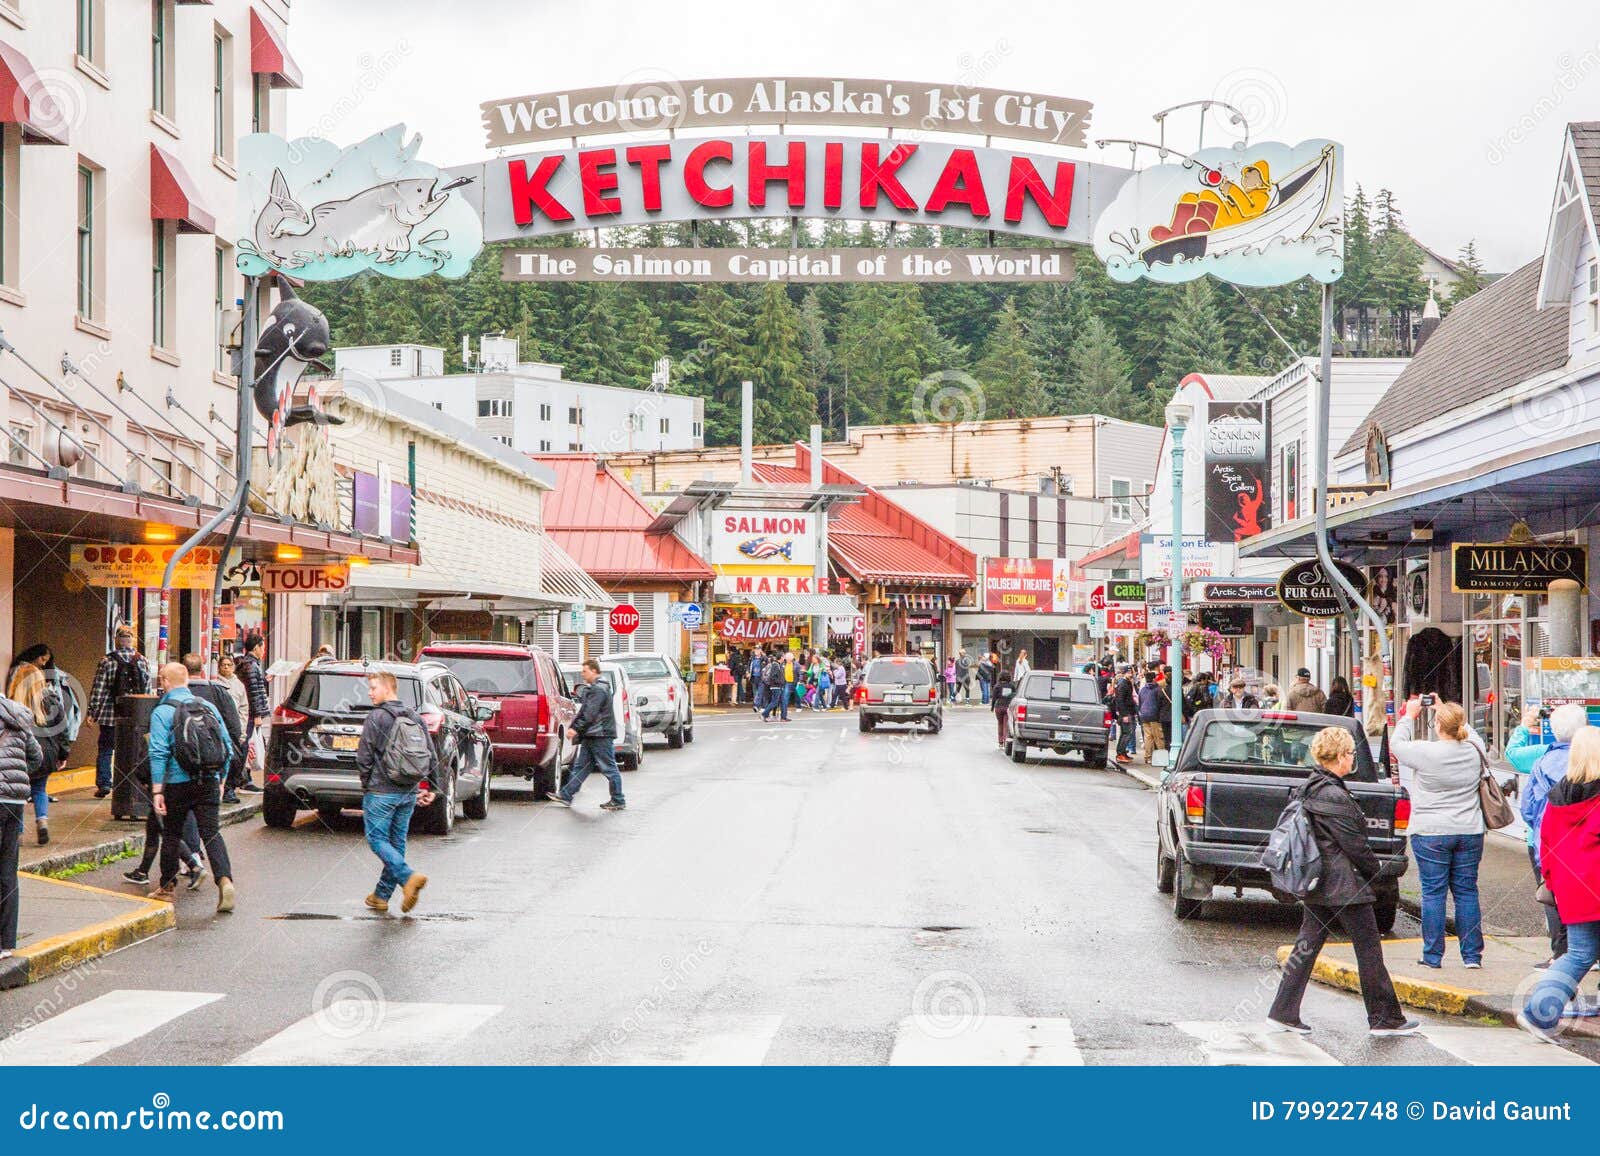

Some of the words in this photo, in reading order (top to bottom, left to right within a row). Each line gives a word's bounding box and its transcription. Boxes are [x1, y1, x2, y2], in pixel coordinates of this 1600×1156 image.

[496, 91, 681, 135] Welcome
[691, 86, 734, 115] to
[745, 81, 910, 117] Alaska's
[923, 89, 984, 122] 1st
[994, 95, 1076, 144] City
[508, 140, 1077, 228] KETCHIKAN
[515, 254, 577, 276] The
[593, 254, 712, 276] Salmon
[728, 253, 841, 281] Capital
[857, 253, 889, 276] of
[902, 254, 952, 276] the
[968, 253, 1062, 276] World
[1209, 426, 1261, 441] SCANLON
[1212, 464, 1234, 474] Arctic
[1221, 473, 1242, 484] Spirit
[1230, 482, 1255, 493] Gallery
[725, 516, 806, 535] SALMON
[1160, 539, 1194, 548] Salon
[84, 547, 155, 565] ORCA
[1470, 549, 1572, 572] MILANO
[266, 569, 345, 589] TOURS
[1163, 567, 1211, 577] SAMON
[736, 576, 850, 595] MARKET
[987, 577, 1021, 590] COLISEUM
[1023, 578, 1052, 591] THEATRE
[1003, 593, 1037, 606] KETCHIKAN
[1210, 586, 1237, 597] Arctic
[1238, 586, 1264, 599] Spirit
[1285, 587, 1308, 598] FUR
[611, 613, 639, 626] STOP
[723, 617, 790, 638] SALMON
